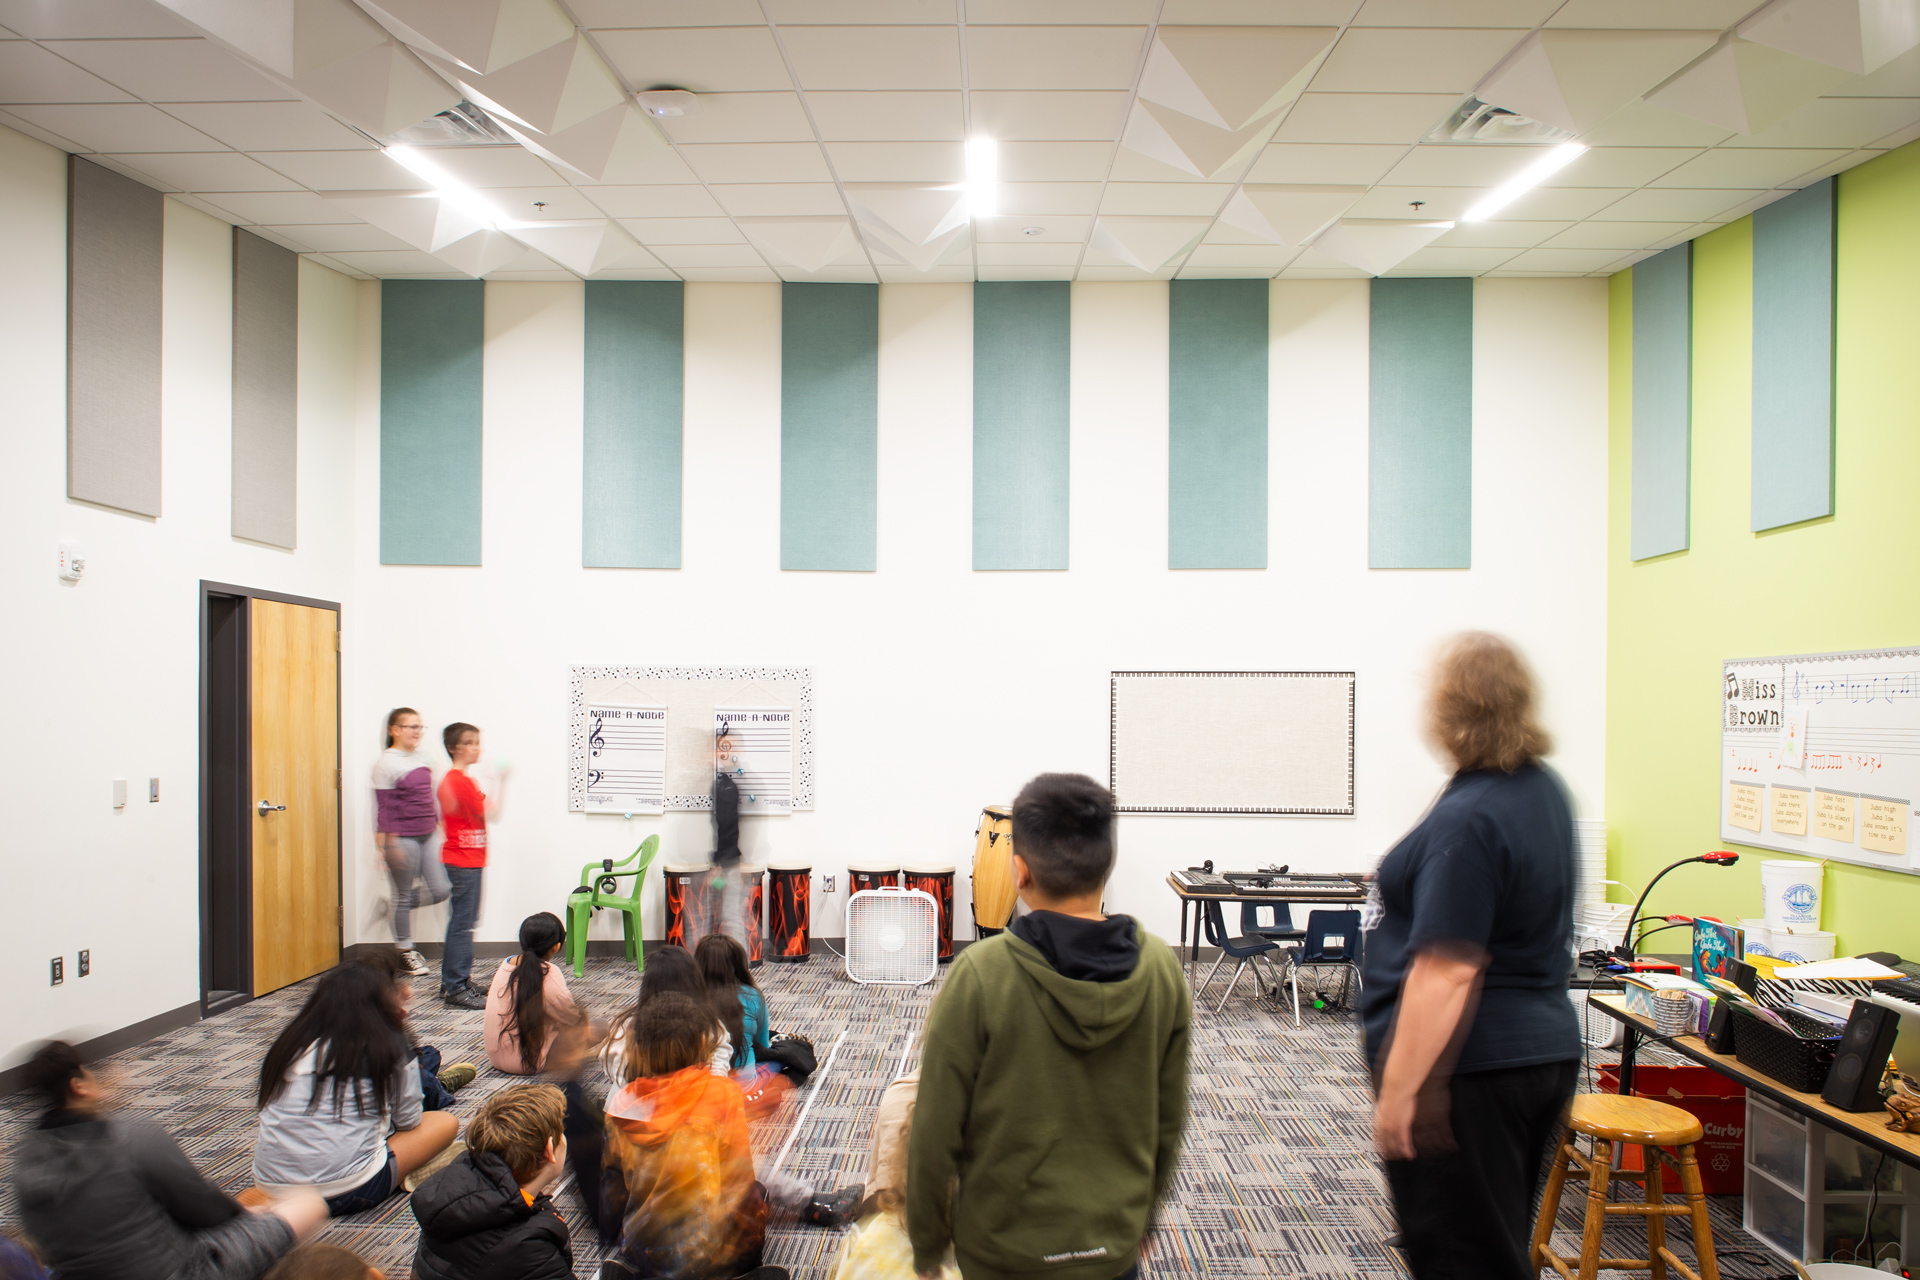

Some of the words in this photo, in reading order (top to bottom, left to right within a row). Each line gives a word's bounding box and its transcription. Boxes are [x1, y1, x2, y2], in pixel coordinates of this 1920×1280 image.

[1742, 678, 1776, 701] Miss
[1729, 704, 1780, 726] Brown
[1704, 1122, 1744, 1138] Curby
